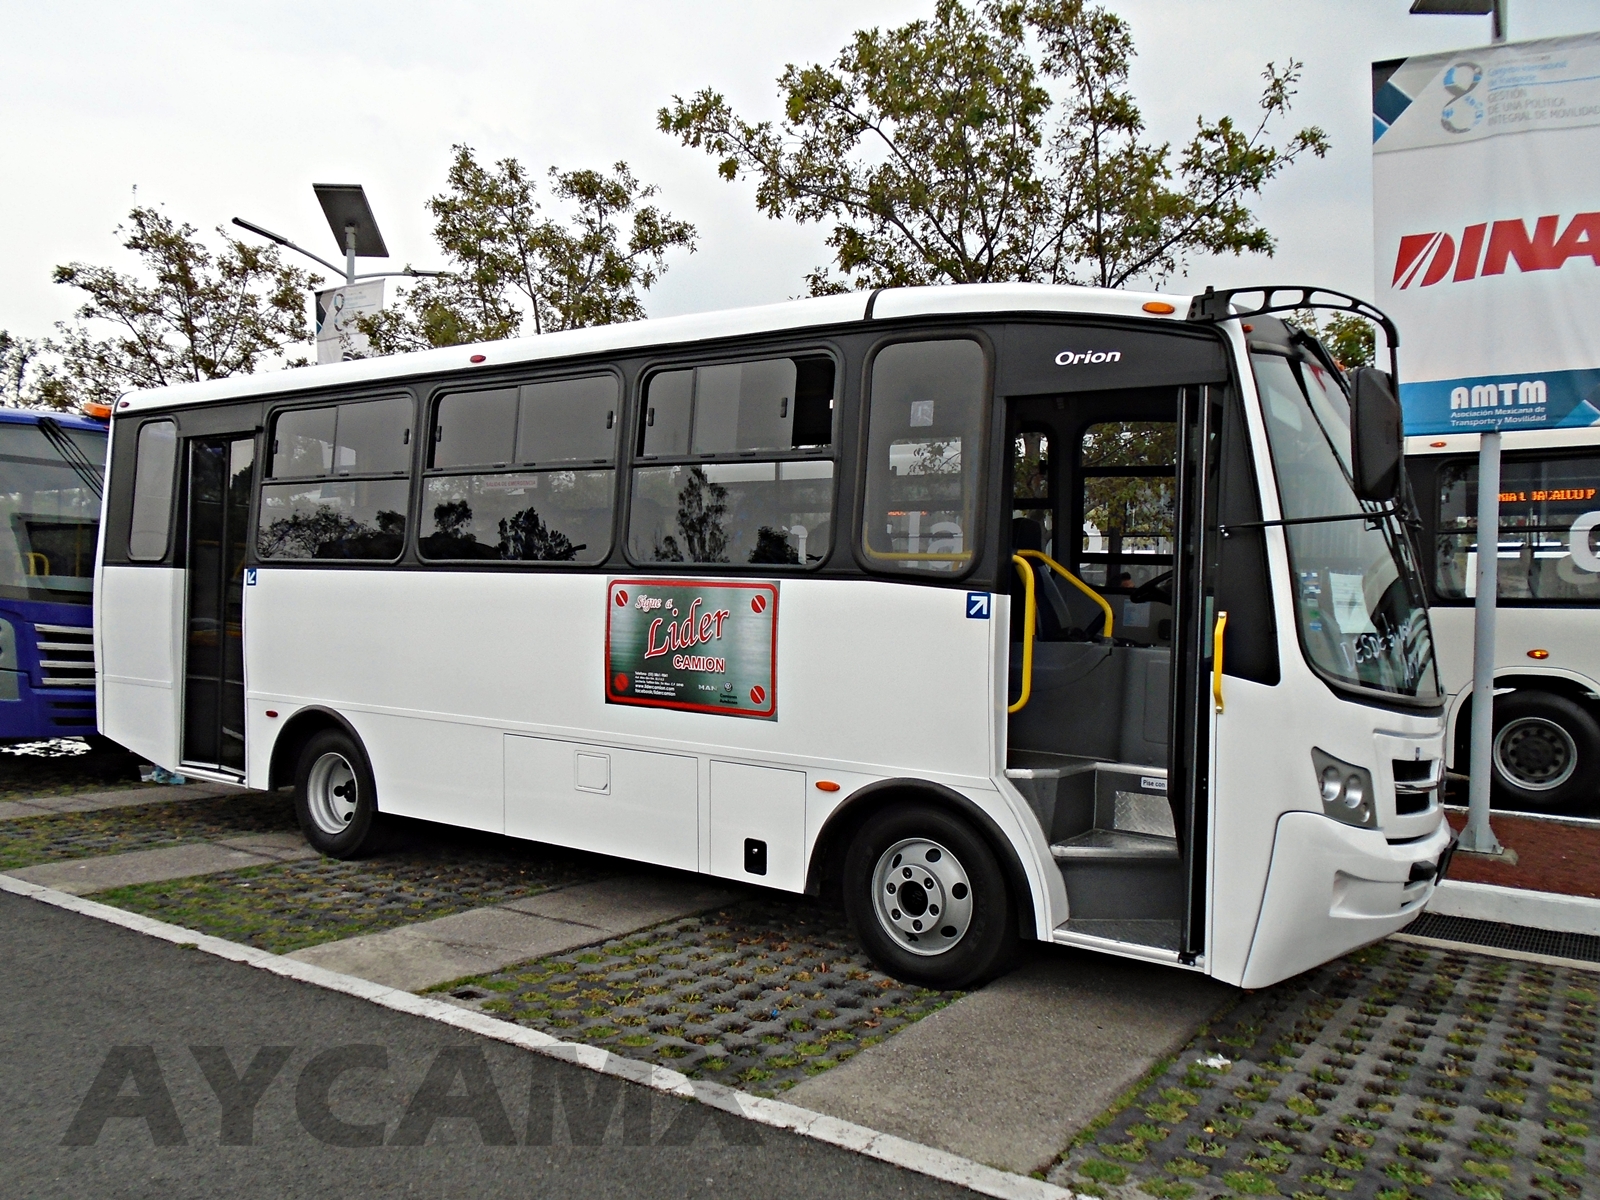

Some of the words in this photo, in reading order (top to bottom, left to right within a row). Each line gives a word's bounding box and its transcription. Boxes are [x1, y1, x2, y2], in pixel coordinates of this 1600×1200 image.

[1391, 212, 1600, 290] DINA
[1055, 350, 1121, 366] Orion
[1451, 380, 1547, 410] AMTM
[1451, 409, 1494, 418] Asociación
[1494, 407, 1533, 415] Mexicana
[1451, 417, 1496, 427] Transporte
[1504, 414, 1547, 423] Movilidad
[635, 594, 662, 612] Sigue
[665, 598, 674, 609] a
[644, 597, 730, 659] Lider
[672, 654, 725, 673] CAMION
[1143, 779, 1154, 787] Pise
